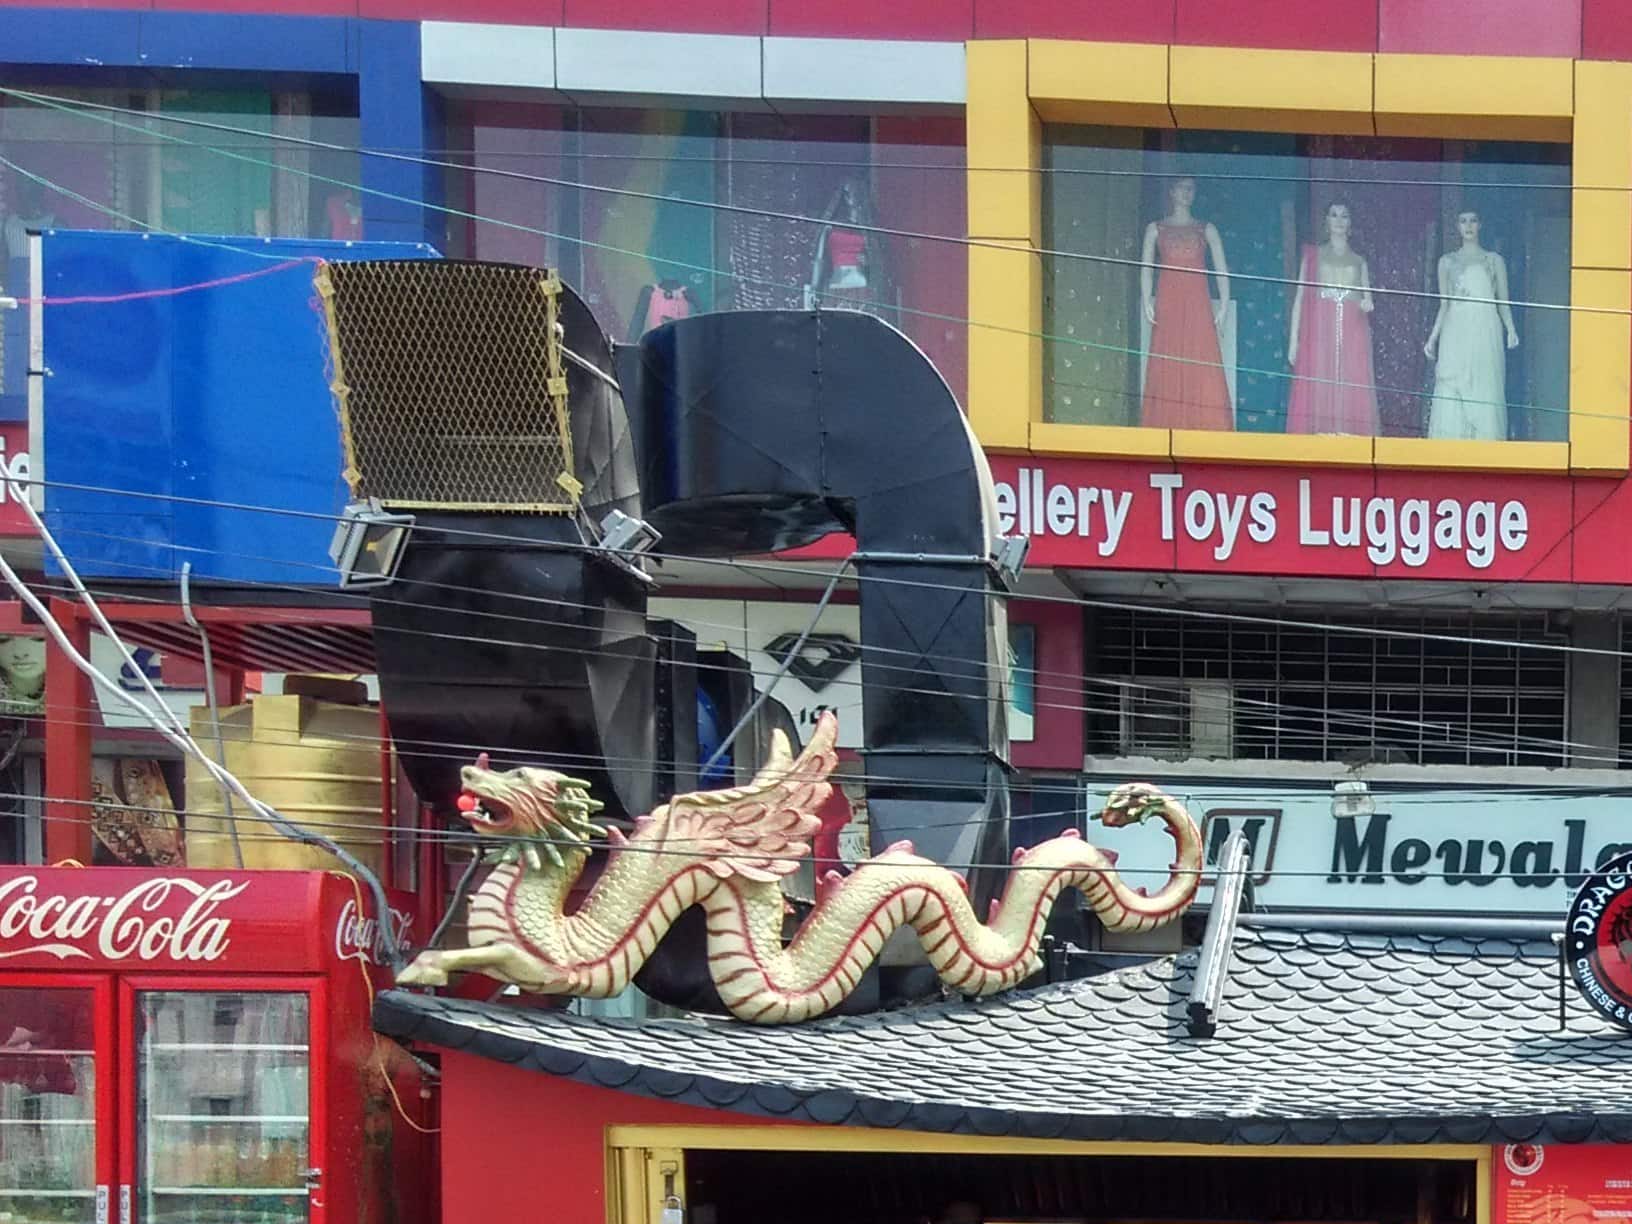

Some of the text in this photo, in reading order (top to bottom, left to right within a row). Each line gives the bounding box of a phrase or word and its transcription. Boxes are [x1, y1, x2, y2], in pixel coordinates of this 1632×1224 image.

[1149, 473, 1276, 561] Toys
[1300, 479, 1529, 568] Luggage
[1576, 957, 1617, 1013] CHINESE
[1614, 1006, 1626, 1019] &
